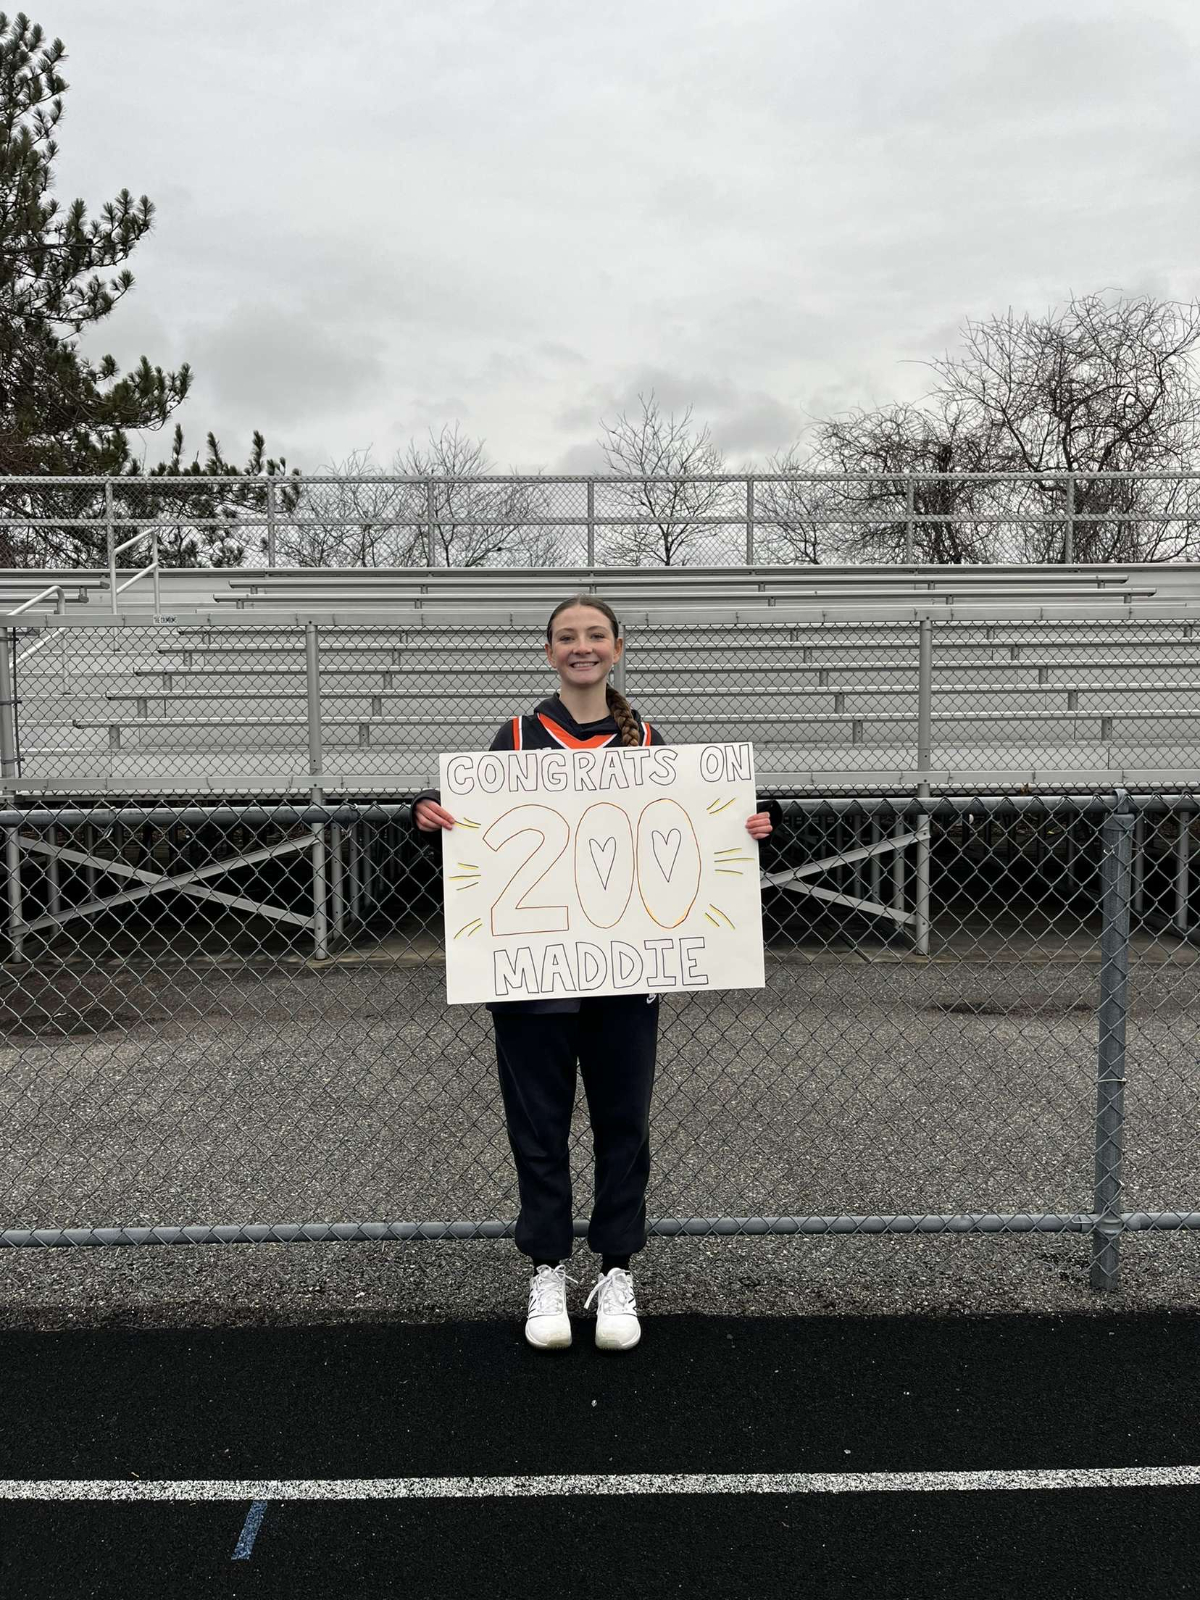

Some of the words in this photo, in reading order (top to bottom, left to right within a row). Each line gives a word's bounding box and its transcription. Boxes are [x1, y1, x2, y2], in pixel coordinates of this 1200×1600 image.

[447, 749, 678, 795] CONGRATS
[700, 744, 751, 783] ON
[482, 798, 701, 936] 200
[494, 937, 709, 996] MADDIE
